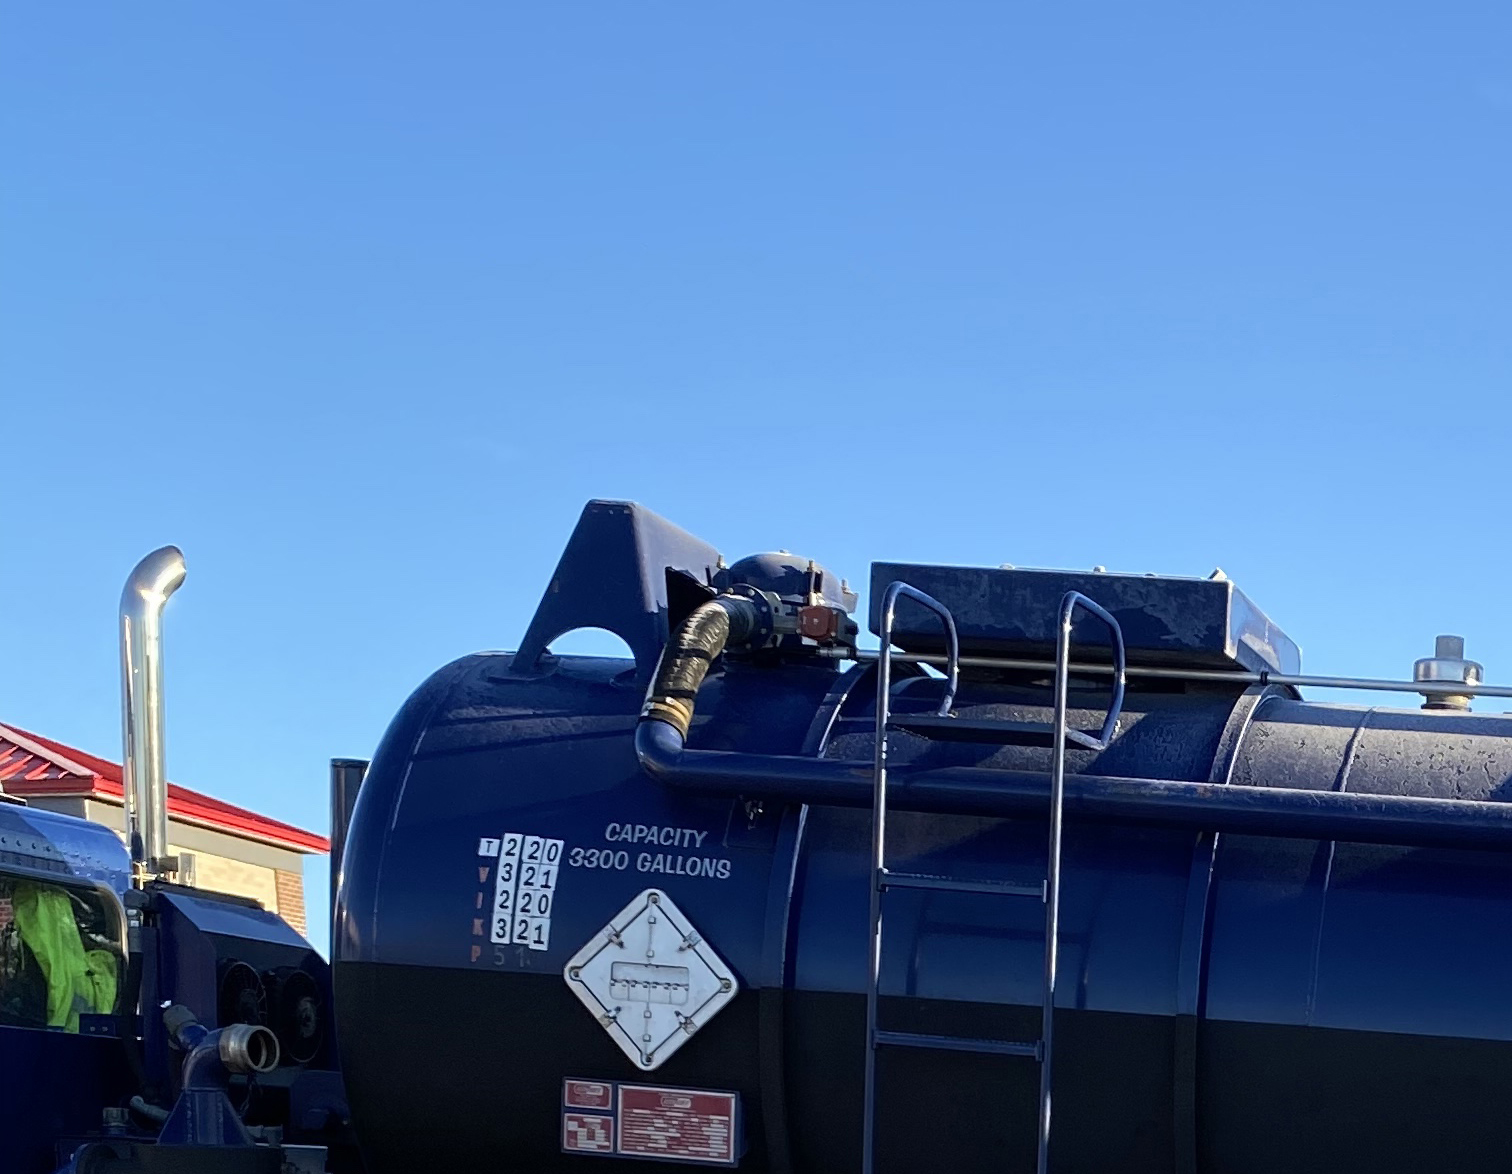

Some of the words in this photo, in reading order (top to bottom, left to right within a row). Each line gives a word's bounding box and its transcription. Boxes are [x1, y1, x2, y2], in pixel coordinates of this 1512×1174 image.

[604, 822, 709, 848] CAPACITY
[568, 847, 630, 871] 3300
[636, 852, 732, 879] GALLONS
